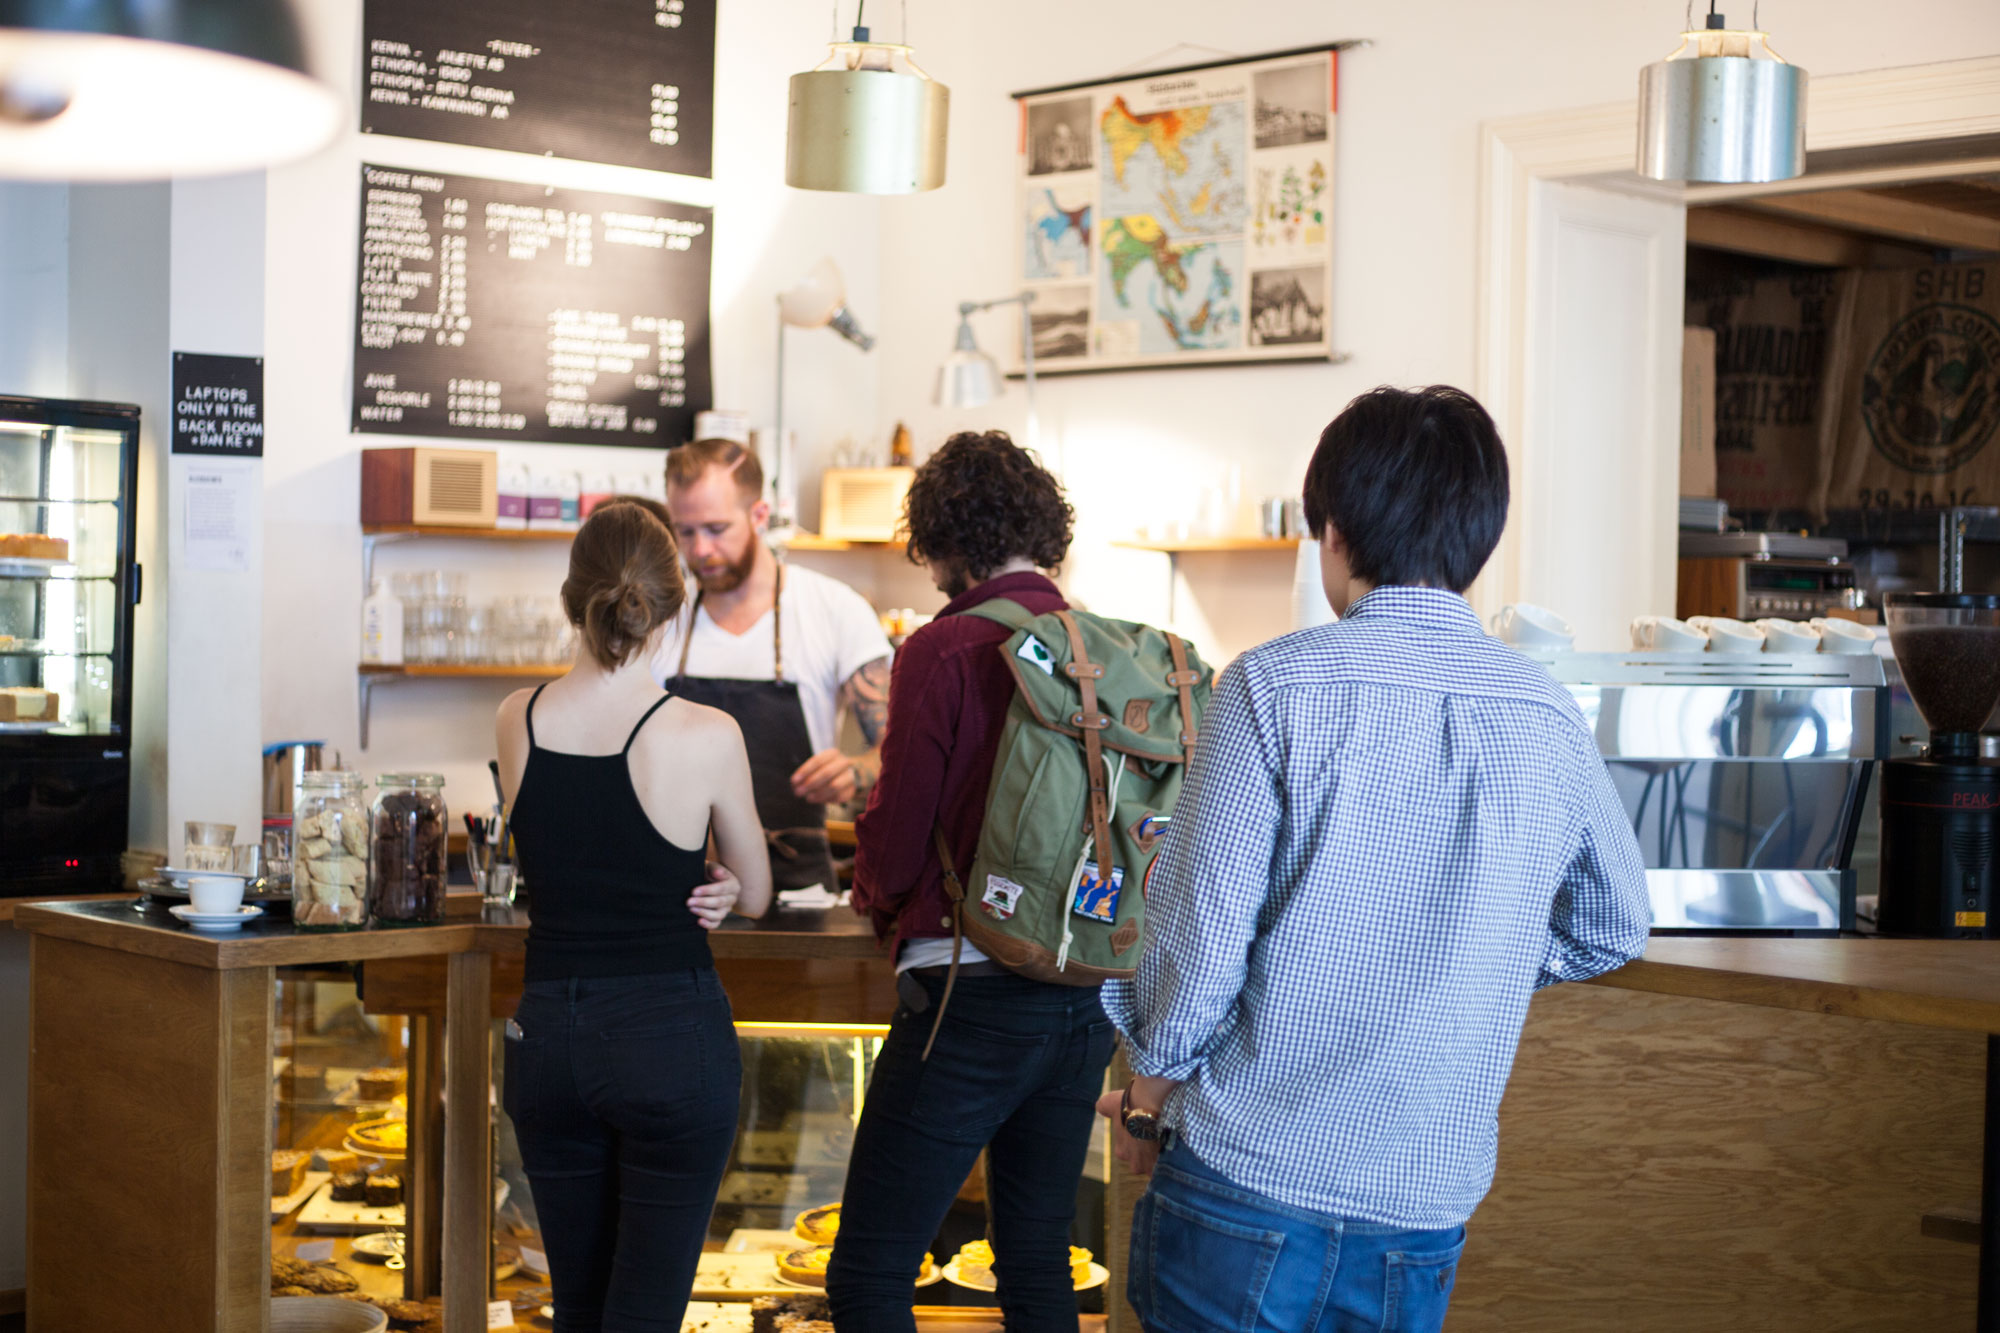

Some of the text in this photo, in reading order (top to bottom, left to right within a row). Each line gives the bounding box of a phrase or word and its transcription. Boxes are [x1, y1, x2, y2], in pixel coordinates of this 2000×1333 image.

[367, 169, 445, 193] COFFEE MENU
[364, 254, 401, 271] LATTE
[363, 267, 393, 283] FLAT
[397, 270, 432, 288] WHITE
[1913, 268, 1986, 301] SHB
[185, 385, 248, 403] LAPTOPS
[177, 400, 256, 418] ONLY IN THE
[360, 405, 403, 422] WATER
[179, 419, 264, 437] BACK ROOM
[1952, 791, 1991, 809] PEAK
